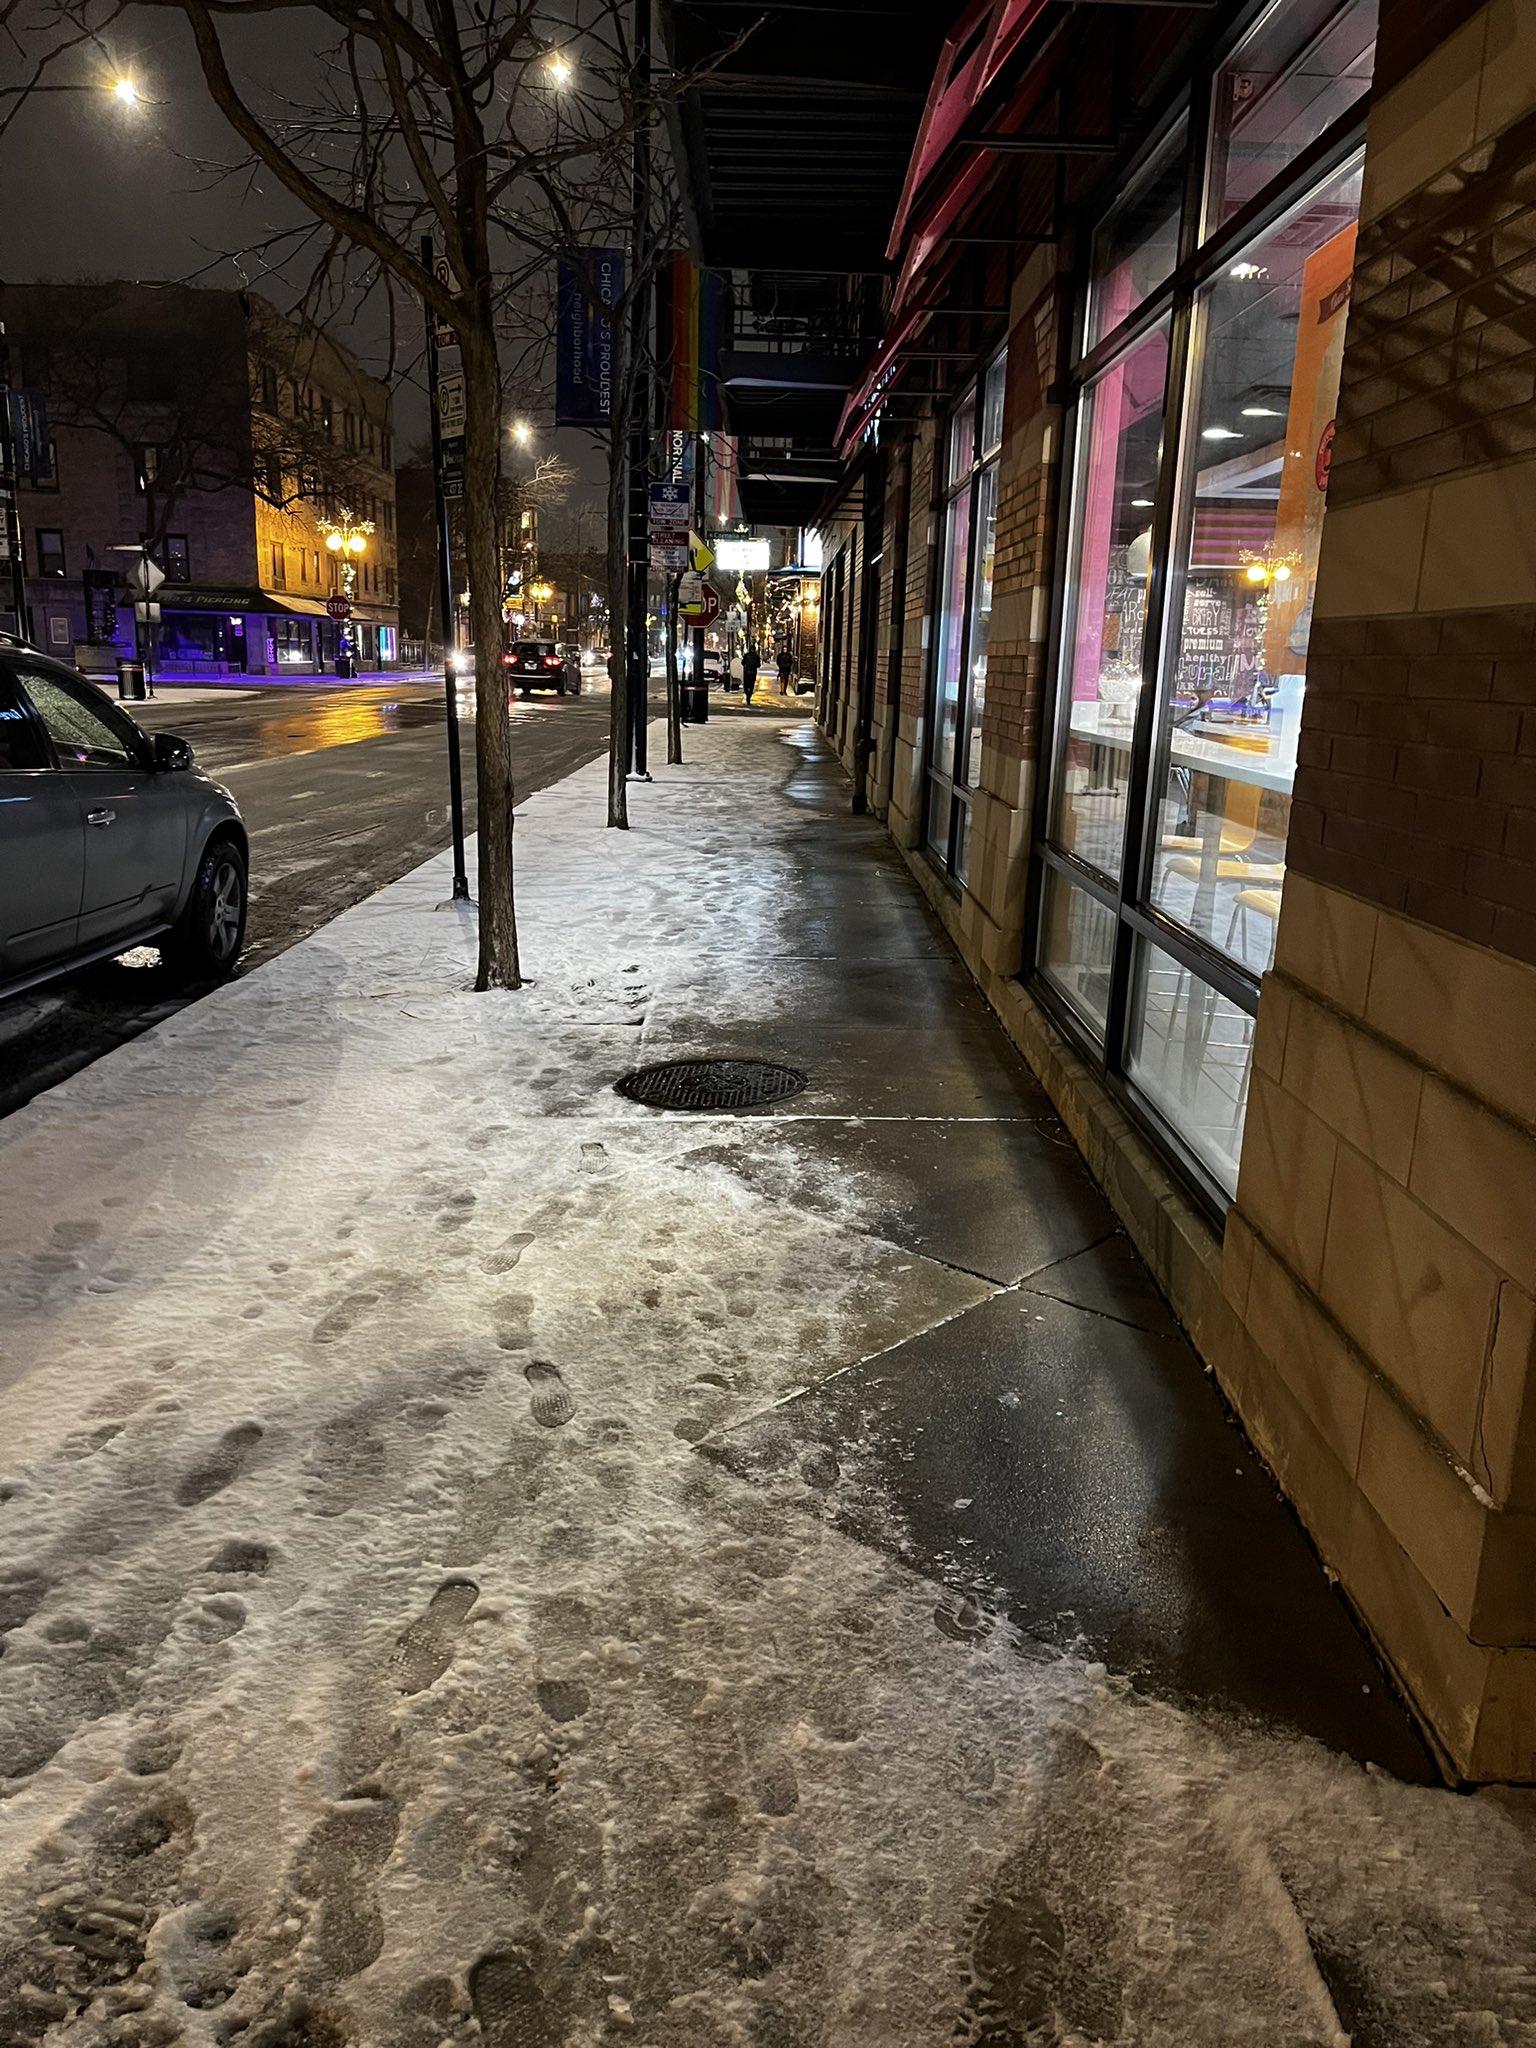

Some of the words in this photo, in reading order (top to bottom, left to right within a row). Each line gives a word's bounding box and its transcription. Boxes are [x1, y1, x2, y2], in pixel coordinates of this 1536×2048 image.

[570, 292, 585, 385] neighborhood
[600, 344, 611, 416] PROUDEST
[327, 602, 350, 613] STOP
[1183, 637, 1224, 653] premium
[1185, 653, 1228, 665] healthy
